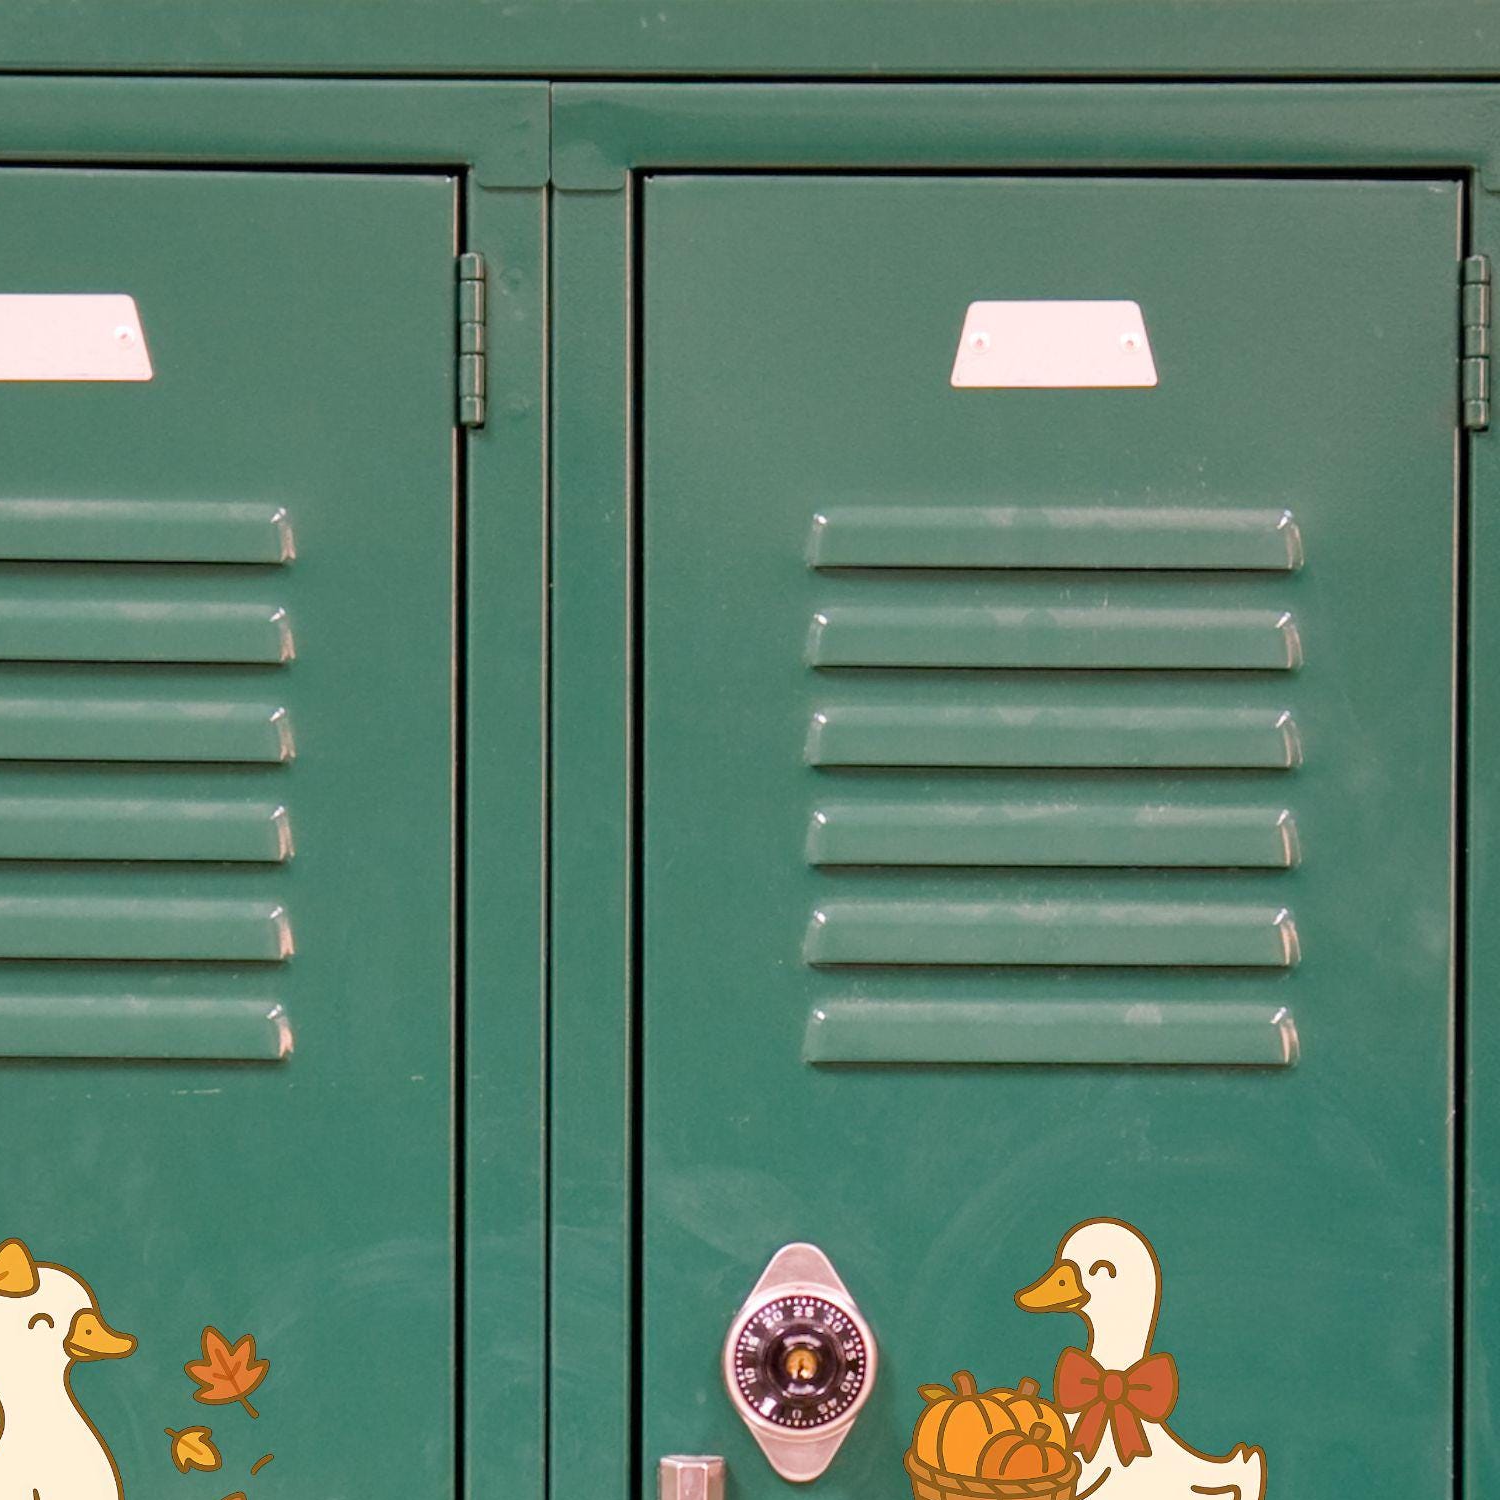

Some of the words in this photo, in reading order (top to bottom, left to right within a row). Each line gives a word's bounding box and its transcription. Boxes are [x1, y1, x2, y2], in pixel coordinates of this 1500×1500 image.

[762, 1312, 783, 1329] 20
[793, 1306, 814, 1318] 25
[823, 1313, 843, 1332] 30
